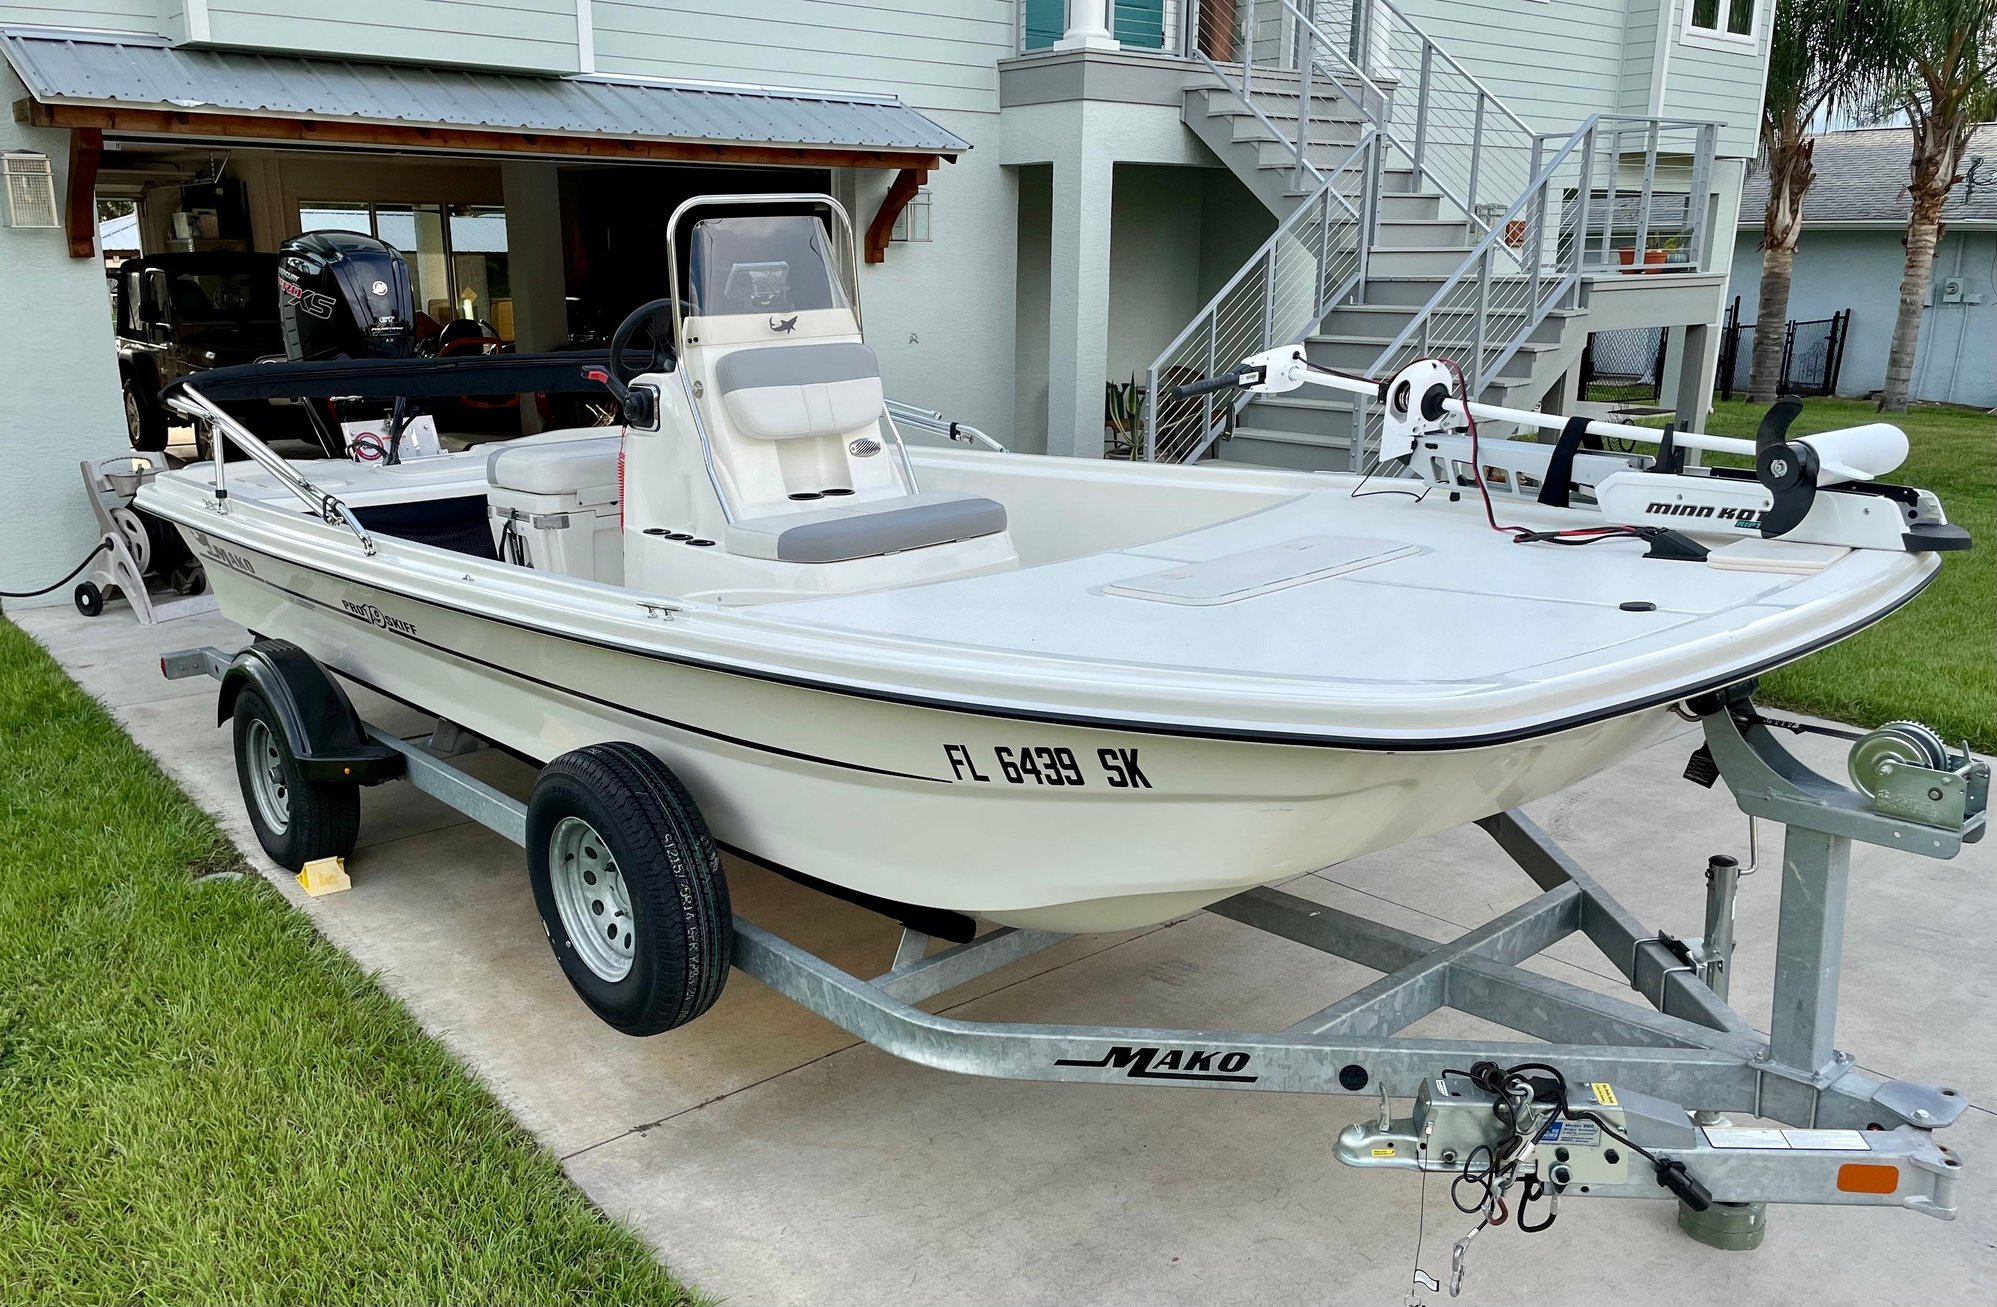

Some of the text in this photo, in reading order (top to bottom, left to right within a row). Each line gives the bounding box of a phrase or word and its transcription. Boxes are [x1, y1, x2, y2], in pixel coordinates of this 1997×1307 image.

[287, 289, 337, 320] XS
[1717, 507, 1769, 521] KOT
[1736, 520, 1761, 529] RIPT
[206, 544, 256, 575] MAKO
[341, 599, 417, 636] PRO 19 SKIFF
[943, 743, 1154, 789] FL 6439 SK
[1099, 1046, 1255, 1080] MAKO
